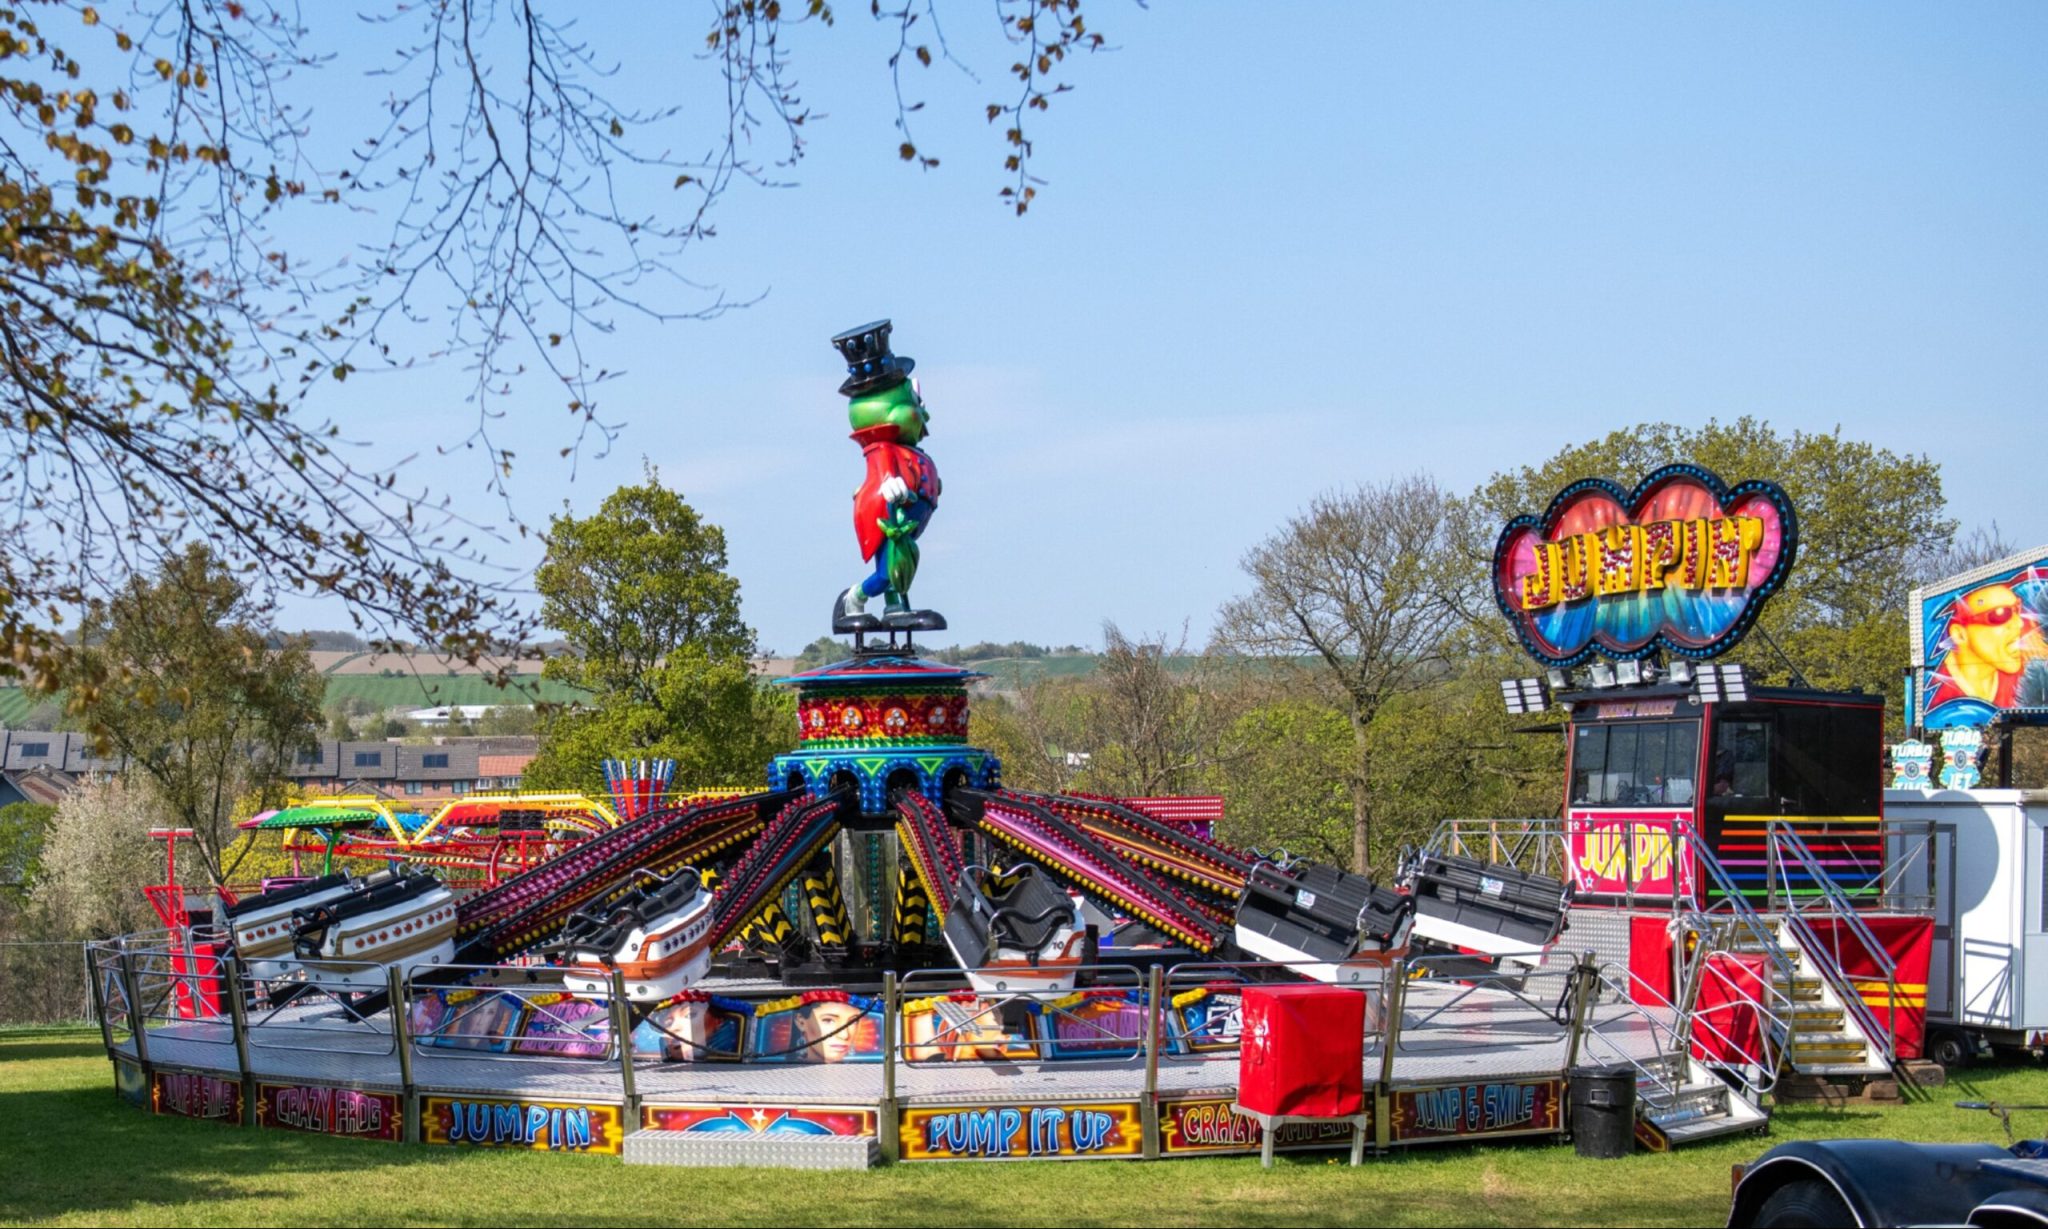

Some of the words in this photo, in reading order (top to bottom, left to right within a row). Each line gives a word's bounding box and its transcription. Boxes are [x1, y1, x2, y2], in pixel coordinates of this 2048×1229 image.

[1891, 744, 1933, 758] TURBO
[1940, 730, 1982, 747] TURBO
[1948, 773, 1973, 790] JET
[1052, 941, 1064, 950] 10
[276, 1087, 332, 1132] CRAZY
[335, 1089, 382, 1133] FROG
[450, 1101, 591, 1147] JUMPIN
[1183, 1104, 1261, 1144] CRAZY
[1415, 1087, 1462, 1131] JUMP
[1465, 1085, 1480, 1131] &
[1484, 1084, 1536, 1130] SMILE
[928, 1108, 1021, 1153] PUMP
[1030, 1107, 1066, 1154] IT
[1071, 1110, 1112, 1151] UP
